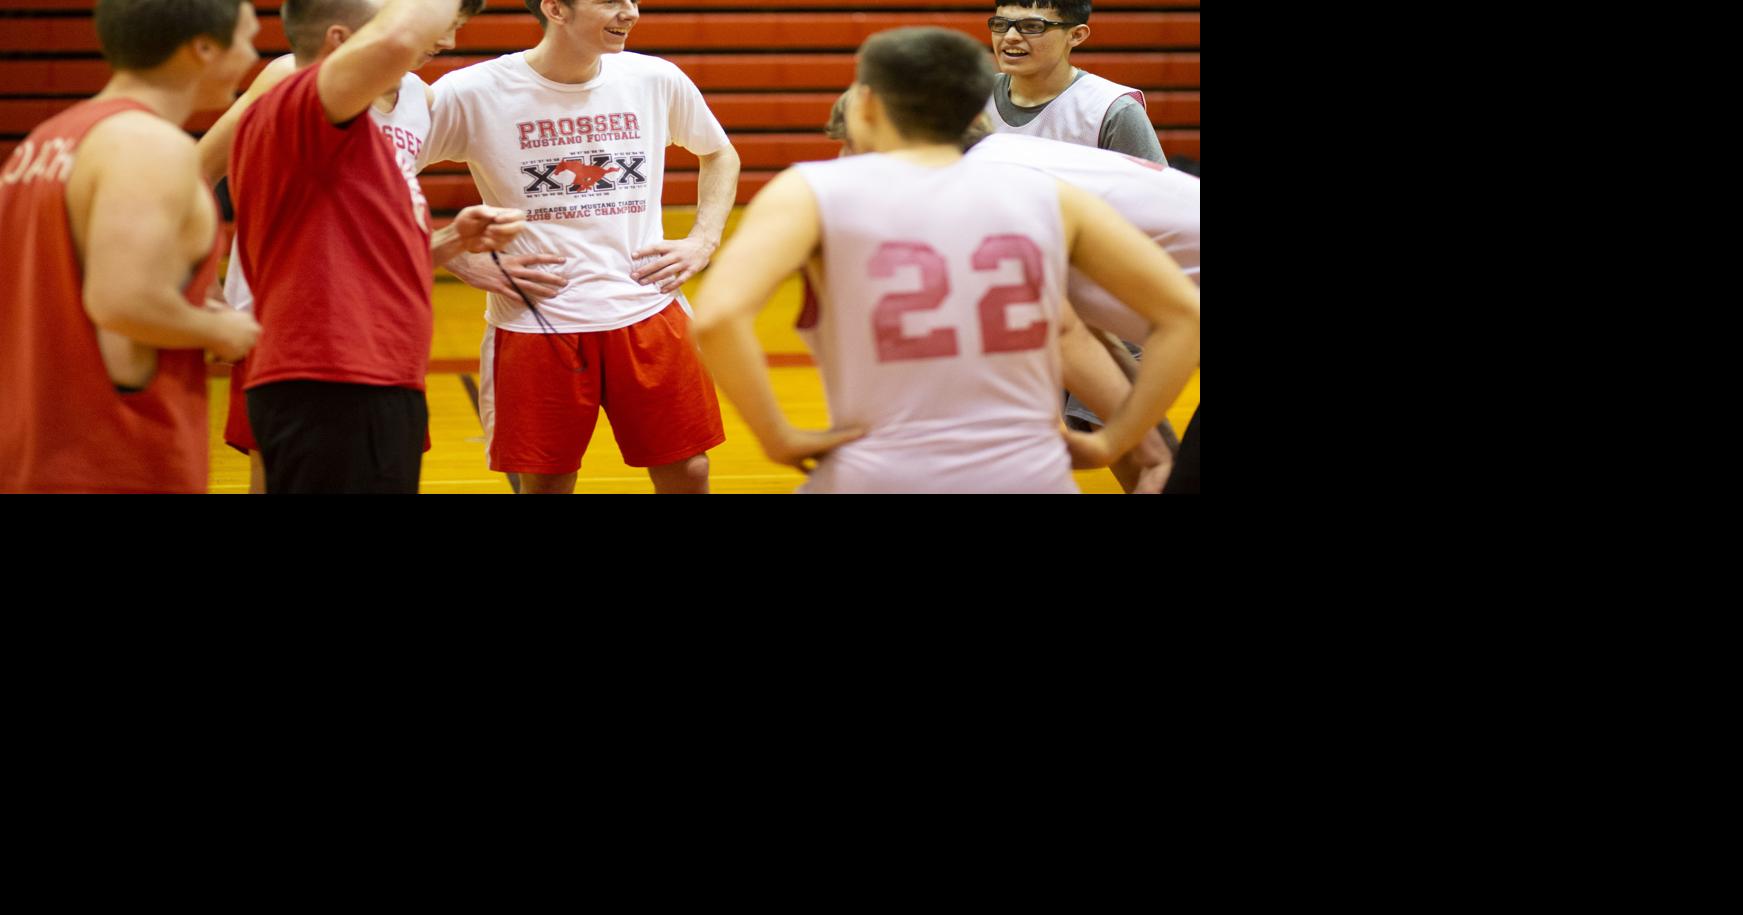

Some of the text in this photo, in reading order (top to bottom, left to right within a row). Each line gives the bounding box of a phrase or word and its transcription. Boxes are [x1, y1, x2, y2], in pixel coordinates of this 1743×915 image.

[517, 112, 640, 140] PROSSER
[520, 131, 640, 150] MUSTANG FOOTBALL
[534, 206, 567, 214] DECADES
[580, 201, 616, 210] MUSTANG
[555, 208, 591, 219] CWAC
[868, 233, 1048, 363] 22
